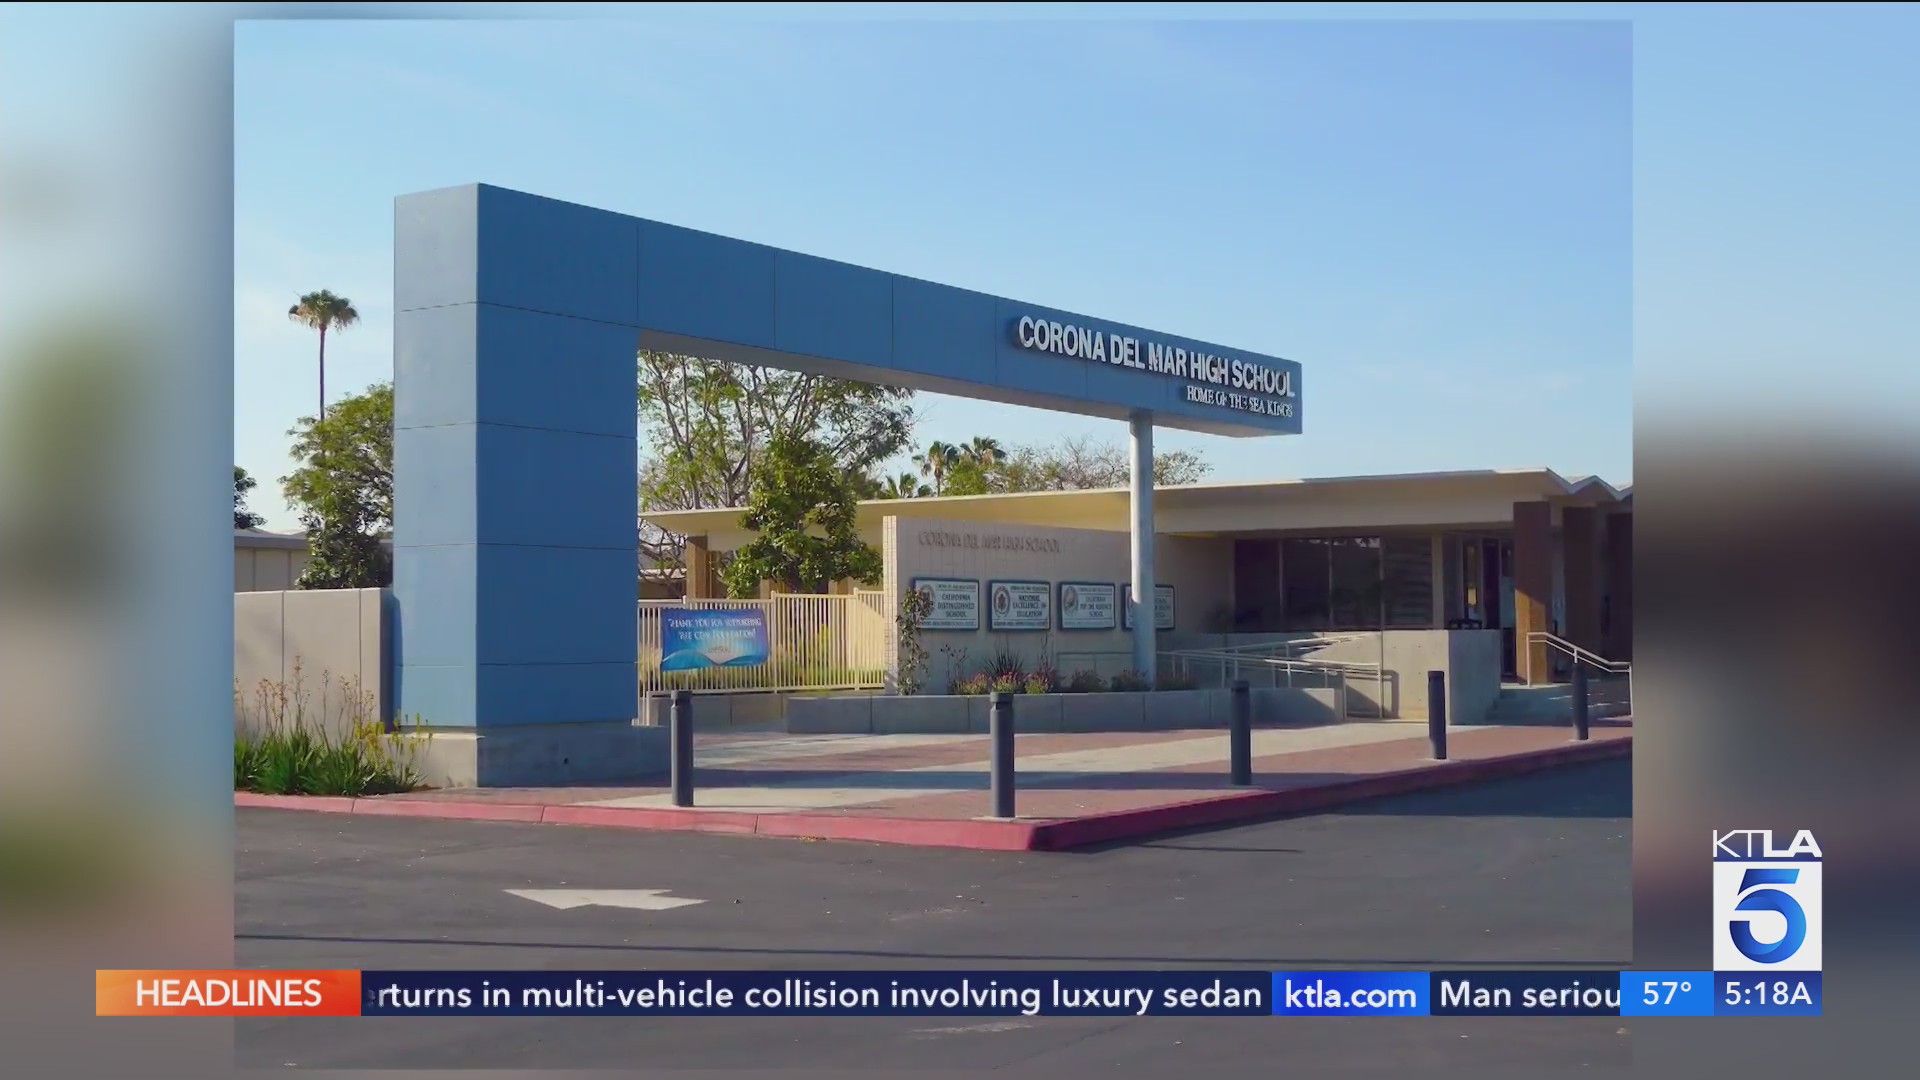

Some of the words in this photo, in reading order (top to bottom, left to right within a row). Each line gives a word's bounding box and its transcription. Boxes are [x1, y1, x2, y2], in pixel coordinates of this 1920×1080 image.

[1018, 315, 1107, 363] CORONA
[1110, 334, 1146, 370] DEL
[1148, 341, 1188, 378] MAR
[1190, 351, 1229, 385] HIGH
[1231, 359, 1295, 398] SCHOOL
[1187, 385, 1214, 405] HOME
[1215, 391, 1228, 406] OF
[1228, 393, 1248, 409] THE
[1249, 397, 1265, 414] SEA
[1266, 400, 1293, 417] KINGS
[918, 530, 961, 548] CORONA
[1025, 536, 1061, 553] SCHOOL
[941, 593, 971, 601] CALIFORNIA
[937, 602, 975, 610] DISTINGUISHED
[945, 610, 967, 618] SCHOOL
[668, 618, 693, 628] THANK
[695, 618, 710, 628] YOU
[711, 618, 723, 627] FOR
